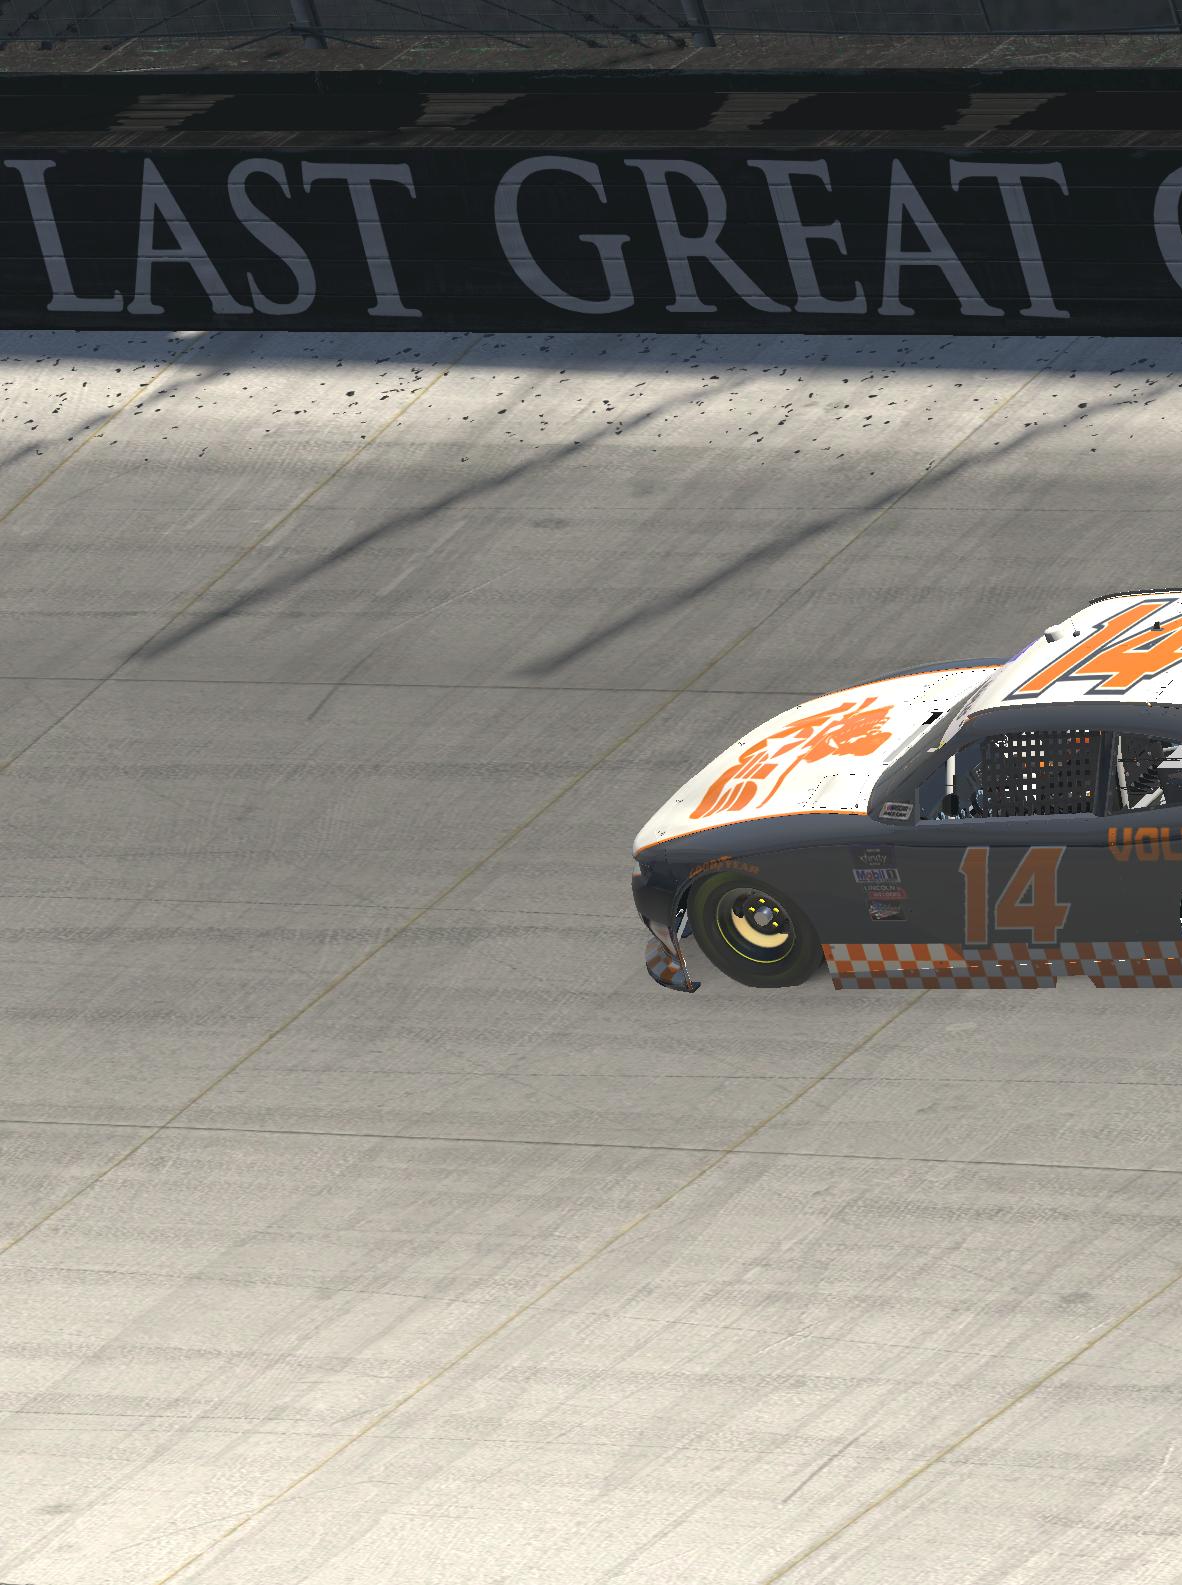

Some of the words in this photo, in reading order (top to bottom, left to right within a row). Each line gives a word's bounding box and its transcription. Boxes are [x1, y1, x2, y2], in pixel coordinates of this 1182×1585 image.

[4, 157, 422, 318] LAST
[494, 155, 1071, 319] GREAT
[958, 846, 1071, 944] 14
